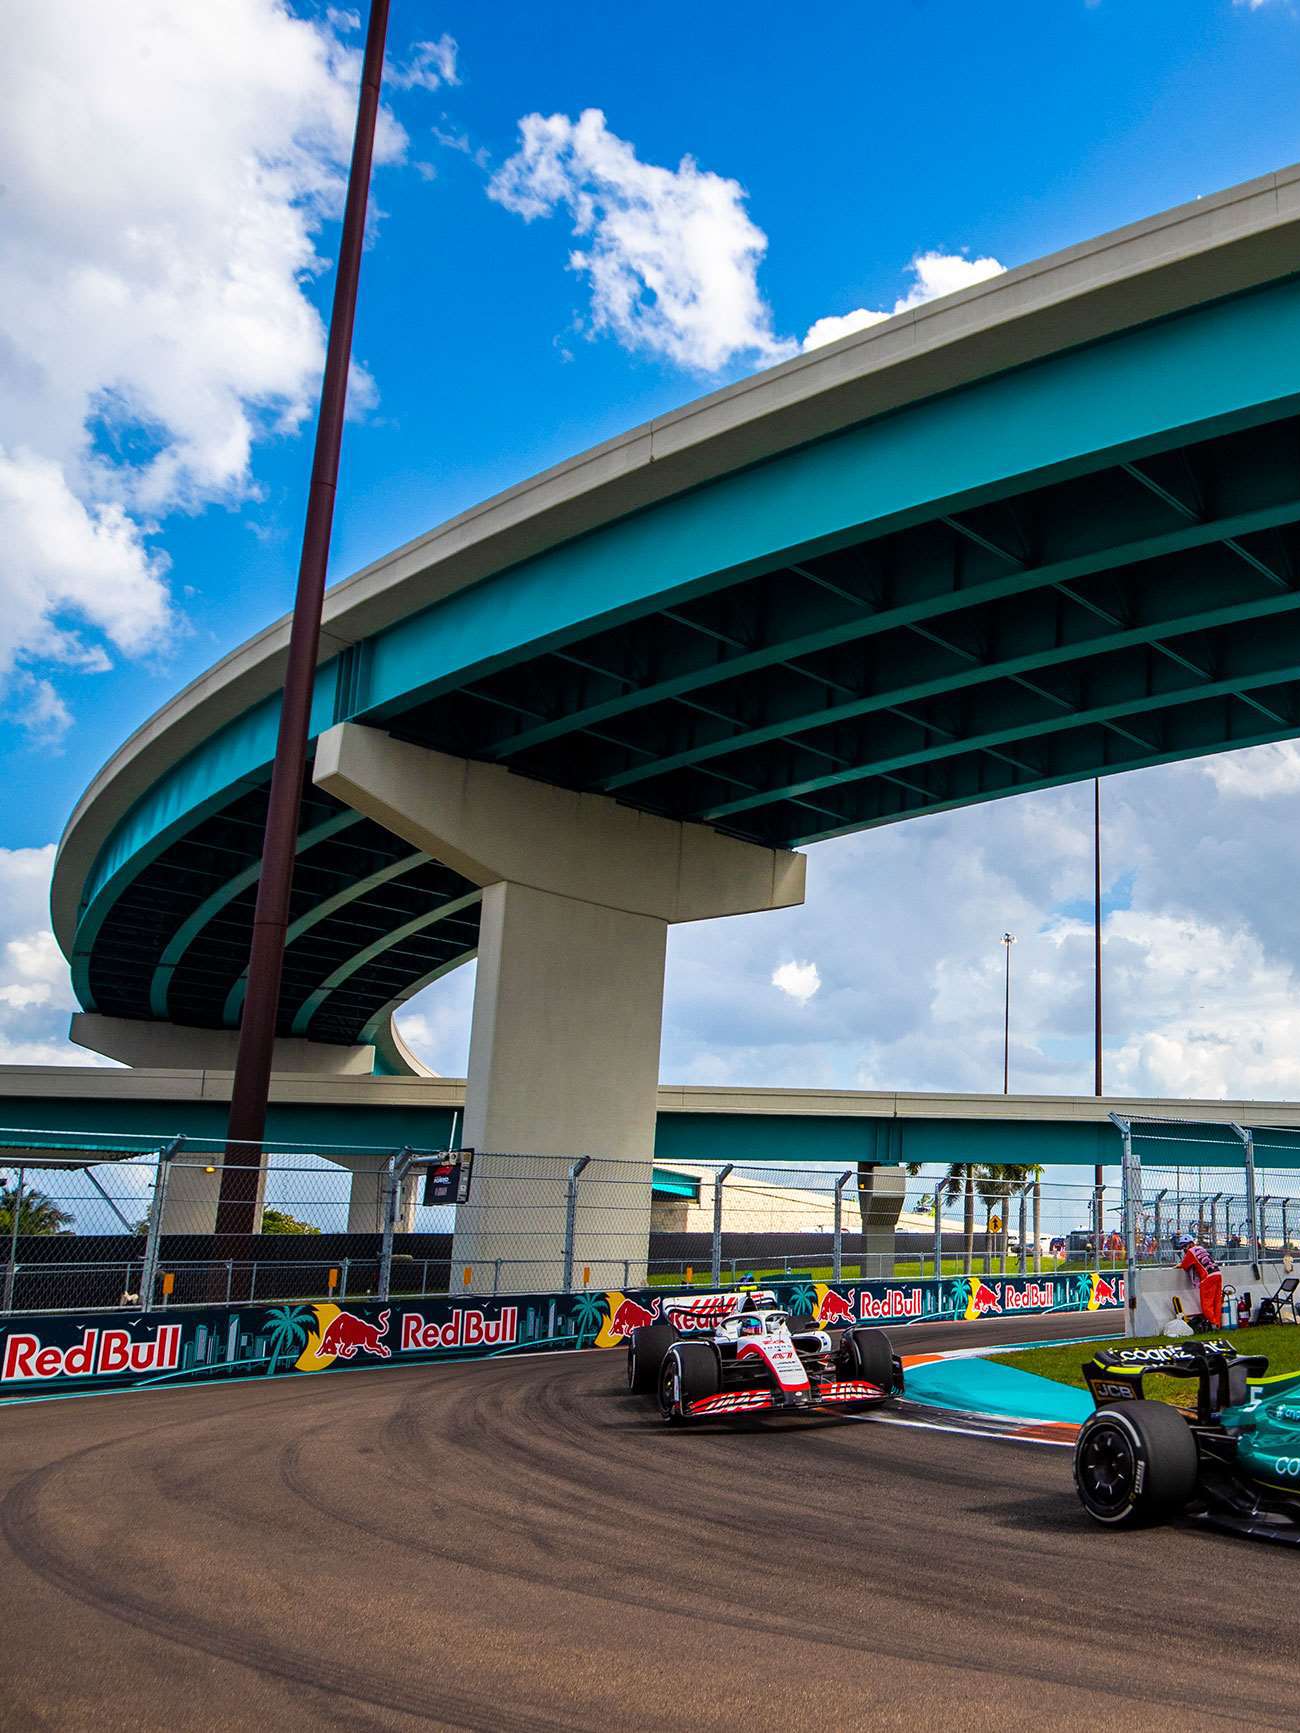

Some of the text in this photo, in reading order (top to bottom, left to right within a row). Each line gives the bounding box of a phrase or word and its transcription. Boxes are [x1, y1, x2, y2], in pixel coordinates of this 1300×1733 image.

[861, 1288, 922, 1319] Red Bull
[1005, 1282, 1054, 1309] Red Bull
[401, 1306, 518, 1351] Red Bull
[1, 1324, 182, 1382] Red Bull
[1098, 1383, 1134, 1399] JCB
[1239, 1386, 1264, 1413] 5
